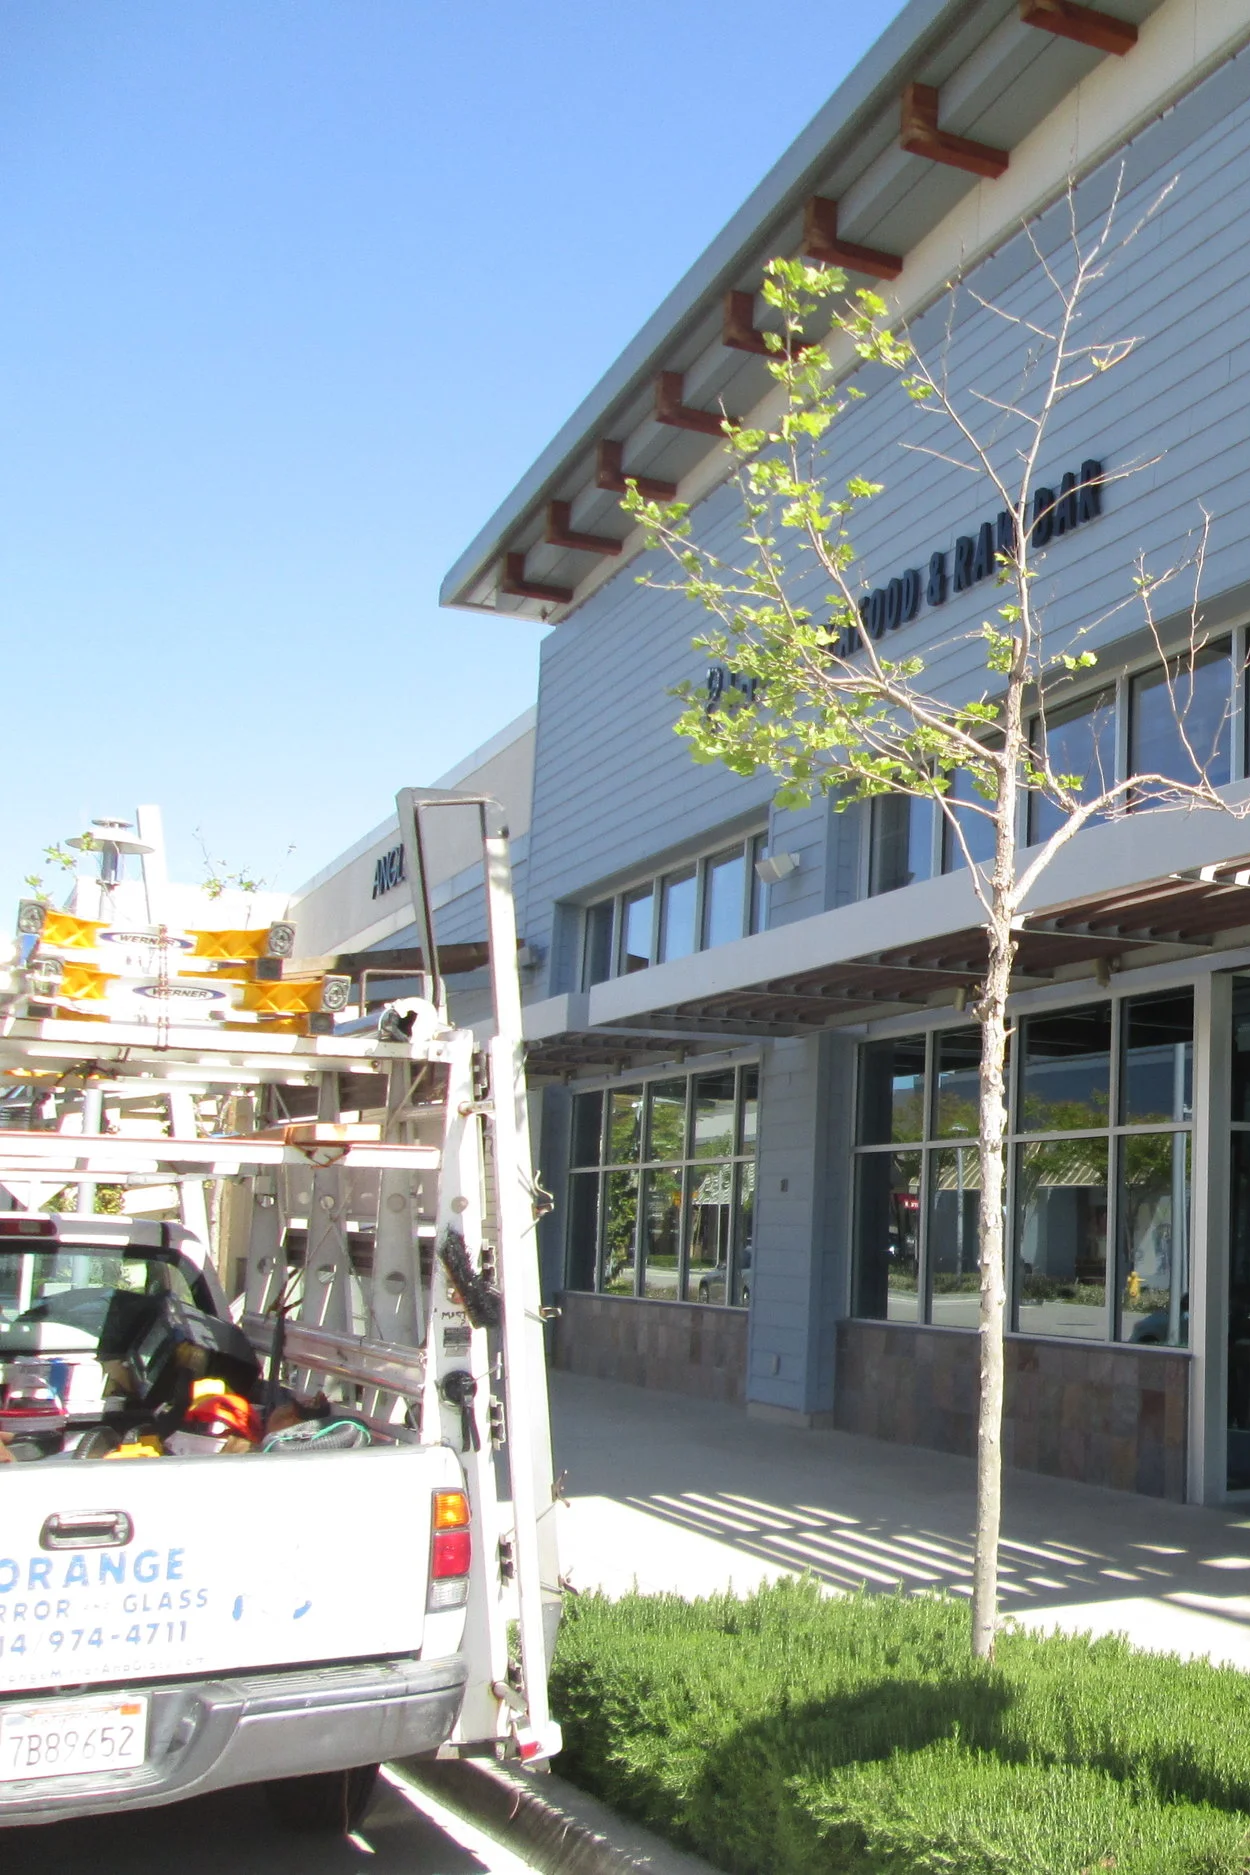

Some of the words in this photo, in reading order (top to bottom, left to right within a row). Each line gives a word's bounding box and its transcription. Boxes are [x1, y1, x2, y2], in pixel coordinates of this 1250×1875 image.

[927, 551, 947, 606] &
[1032, 459, 1102, 548] BAR
[120, 934, 175, 946] WERNR
[0, 1548, 185, 1593] ORANGE
[123, 1588, 208, 1613] GLASS
[9, 1725, 134, 1767] 7B89652
